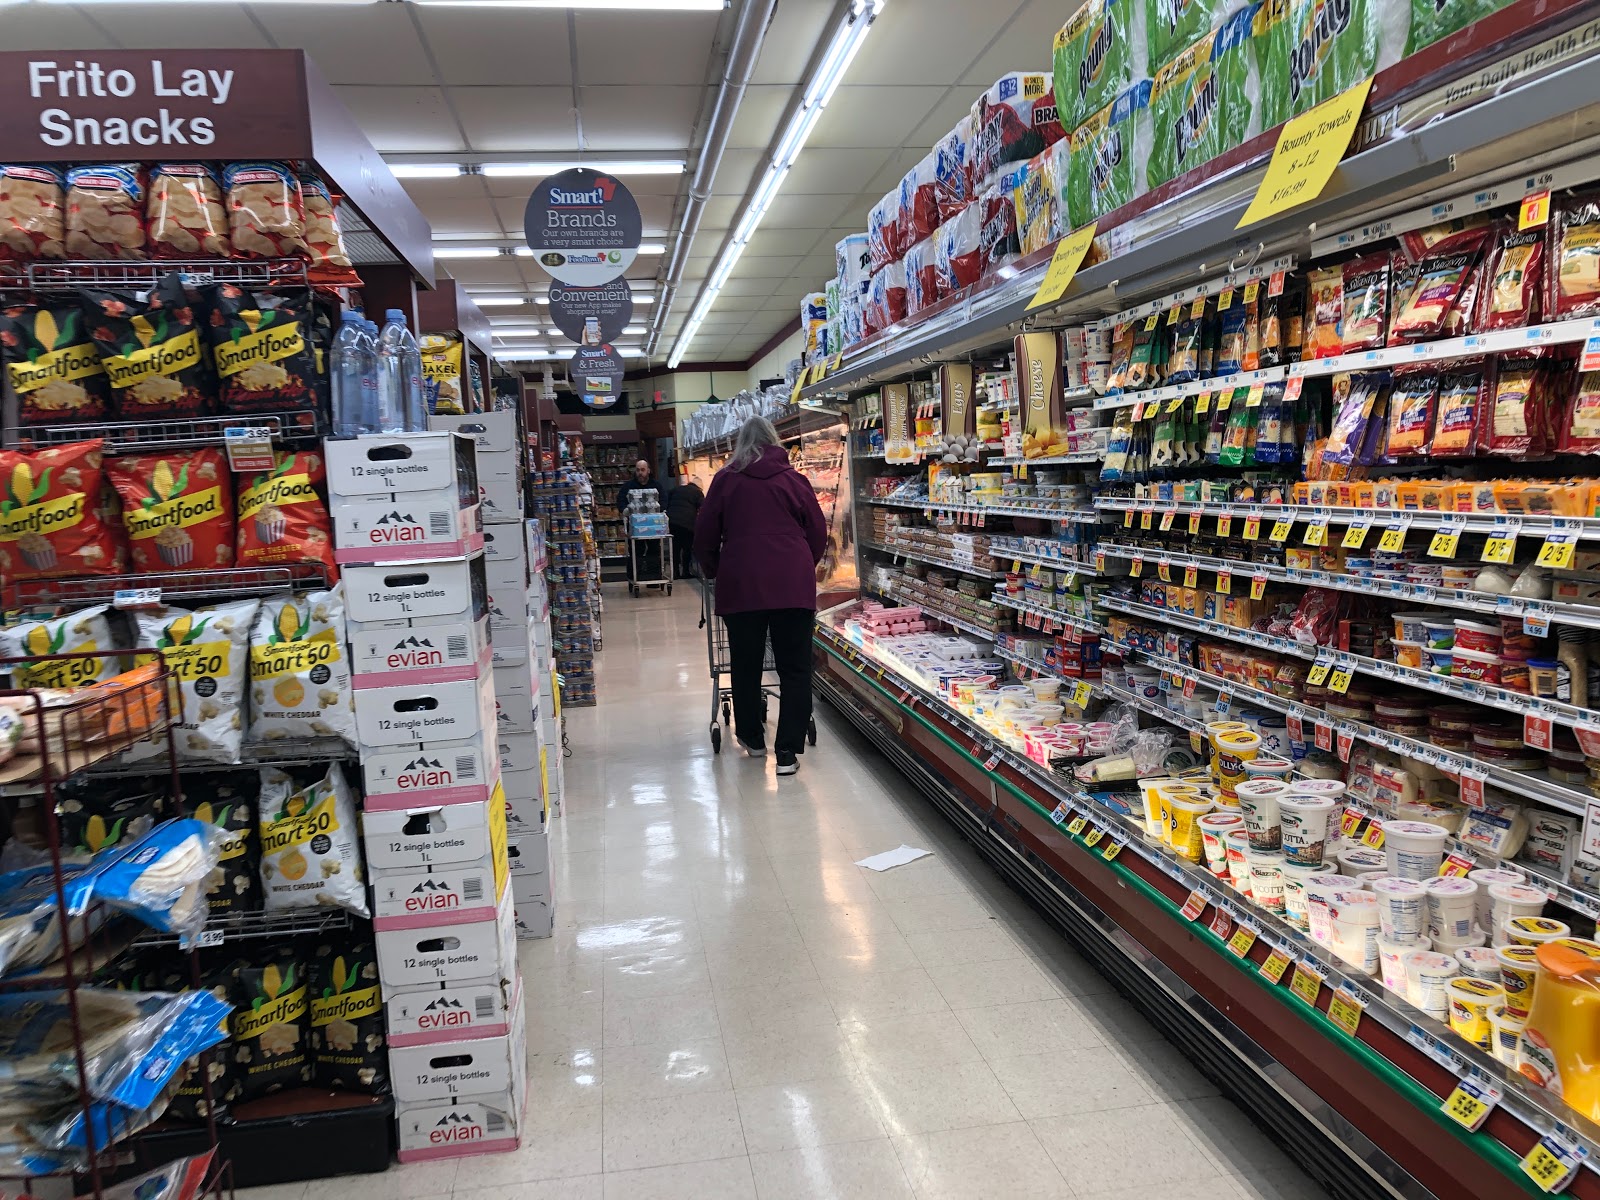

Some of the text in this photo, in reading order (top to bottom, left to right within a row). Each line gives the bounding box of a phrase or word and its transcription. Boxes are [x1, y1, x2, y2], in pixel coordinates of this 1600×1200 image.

[1079, 12, 1112, 100] Bounty
[1445, 38, 1576, 105] Your Daily Health
[28, 60, 234, 104] Frito Lay
[1024, 83, 1044, 96] MORE
[1035, 105, 1060, 125] BRA
[39, 108, 216, 147] Snacks
[1279, 108, 1352, 155] Bounty Towels
[1349, 103, 1402, 153] gurt
[1288, 149, 1320, 174] 8-12
[549, 187, 604, 205] Smart!
[1270, 178, 1307, 204] $16.99
[546, 210, 617, 228] Brands
[542, 229, 559, 237] Our
[579, 228, 610, 237] brands
[550, 240, 569, 248] very
[596, 237, 624, 246] choice
[1427, 256, 1467, 272] SARGENTO
[607, 281, 623, 290] and
[549, 289, 630, 302] Convenient
[109, 338, 196, 382] Smartfood
[581, 349, 607, 358] Smart!
[579, 359, 616, 369] & Fresh
[1030, 359, 1045, 411] Cheese
[952, 382, 965, 415] Eggs
[888, 390, 897, 428] Margarine
[247, 429, 269, 438] 3.99
[351, 464, 428, 476] 12 single bottles
[384, 477, 396, 487] 1L
[128, 494, 216, 533] Smartfood
[370, 525, 425, 542] evian
[368, 589, 445, 602] 12 single bottles
[401, 602, 412, 611] 1L
[1541, 604, 1554, 614] 4.99
[263, 642, 312, 656] Smartfood
[307, 643, 331, 662] 50
[194, 655, 221, 675] 50
[387, 650, 442, 668] evian
[71, 657, 95, 678] 50
[1461, 666, 1485, 676] Good!
[263, 710, 322, 719] WHITE CHEDDAR
[378, 716, 455, 730] 12 single bottles
[411, 730, 422, 739] 1L
[1527, 728, 1547, 739] GLUTEN
[1530, 736, 1545, 747] FREE
[397, 770, 451, 788] evian
[1463, 787, 1480, 799] GLUTEN
[1466, 795, 1478, 805] FREE
[263, 825, 304, 851] mart
[306, 811, 331, 836] 50
[389, 839, 465, 853] 12 single bottles
[421, 852, 432, 862] 1L
[1255, 869, 1277, 877] Biazzo
[293, 881, 325, 891] CHEDDAR
[405, 893, 459, 911] evian
[404, 954, 478, 968] 12 single bottles
[1315, 961, 1329, 976] 3.69
[435, 968, 446, 977] 1L
[1354, 989, 1370, 1004] 3.69
[311, 991, 377, 1022] Smartfood
[235, 999, 307, 1038] Smartfoo
[418, 1010, 471, 1028] evian
[417, 1070, 490, 1085] 12 single bottles
[448, 1084, 458, 1093] 1L
[430, 1125, 482, 1143] evian
